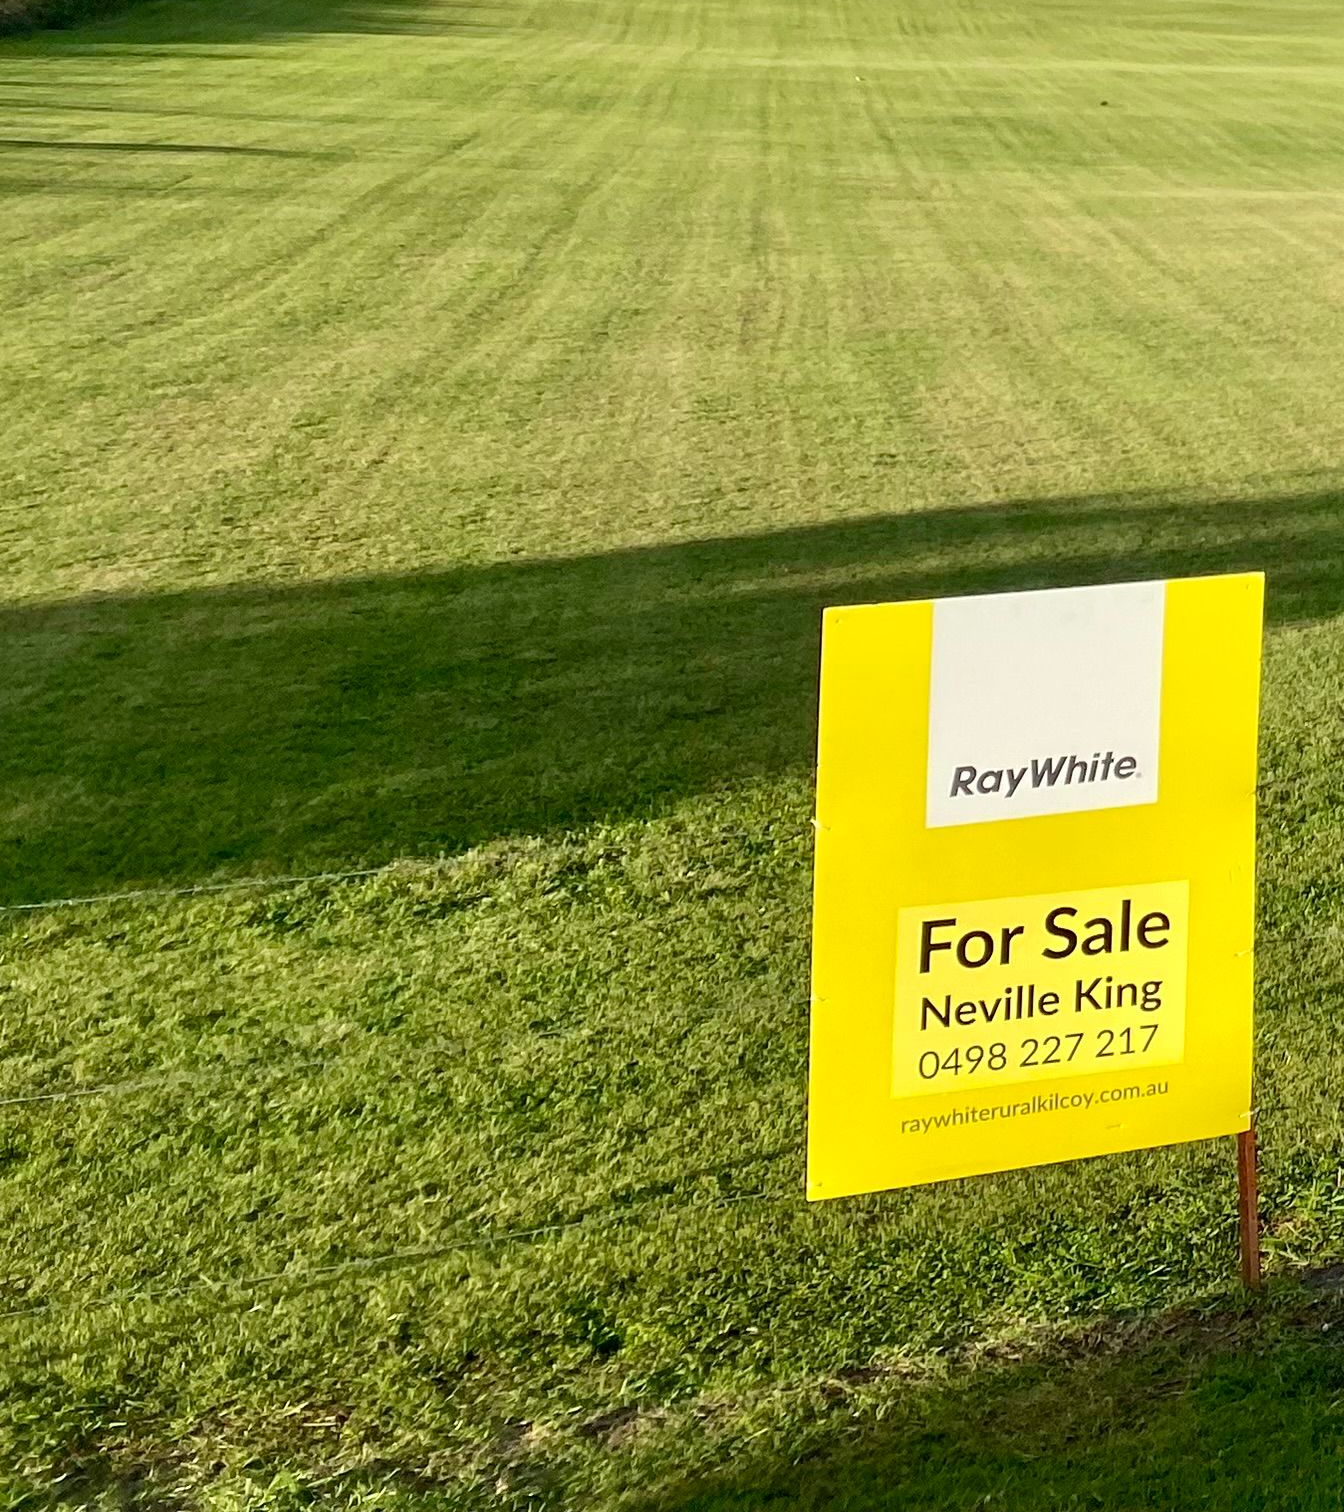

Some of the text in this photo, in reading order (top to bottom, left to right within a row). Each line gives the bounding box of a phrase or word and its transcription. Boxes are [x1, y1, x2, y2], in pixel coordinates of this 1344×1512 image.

[919, 899, 1171, 975] For Sale
[920, 975, 1164, 1032] Neville King
[918, 1024, 1160, 1080] 0498 227 217
[900, 1081, 1170, 1136] raywhiteruralkilcoy.com.au
